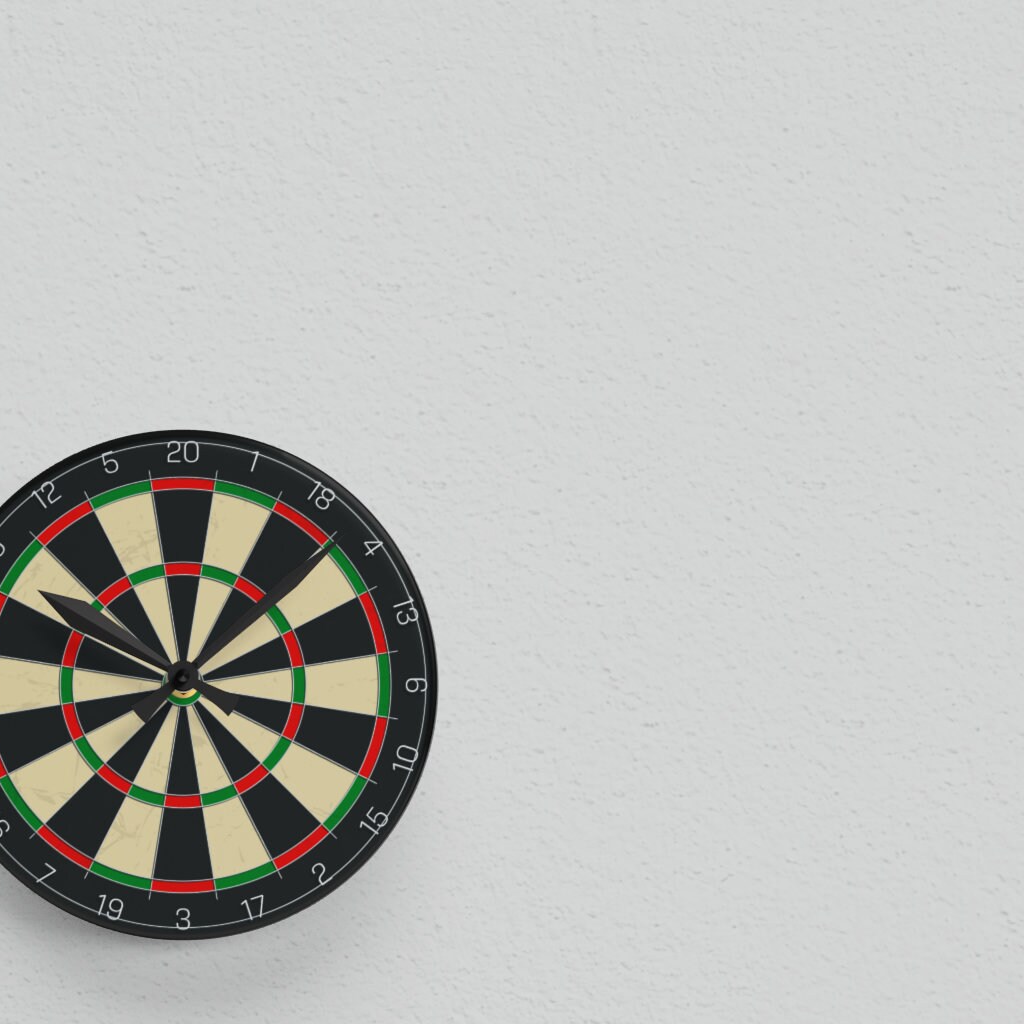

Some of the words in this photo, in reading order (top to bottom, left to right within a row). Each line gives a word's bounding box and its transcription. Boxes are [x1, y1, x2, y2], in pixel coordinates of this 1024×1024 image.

[102, 451, 120, 474] 5
[166, 440, 200, 463] 20
[250, 451, 260, 472] 1
[30, 481, 62, 509] 12
[307, 481, 336, 510] 18
[364, 540, 384, 556] 4
[393, 598, 419, 625] 13
[392, 745, 419, 772] 10
[359, 806, 389, 835] 15
[36, 863, 56, 883] 7
[312, 863, 333, 886] 2
[97, 894, 124, 921] 19
[176, 907, 191, 930] 3
[240, 895, 264, 920] 17
